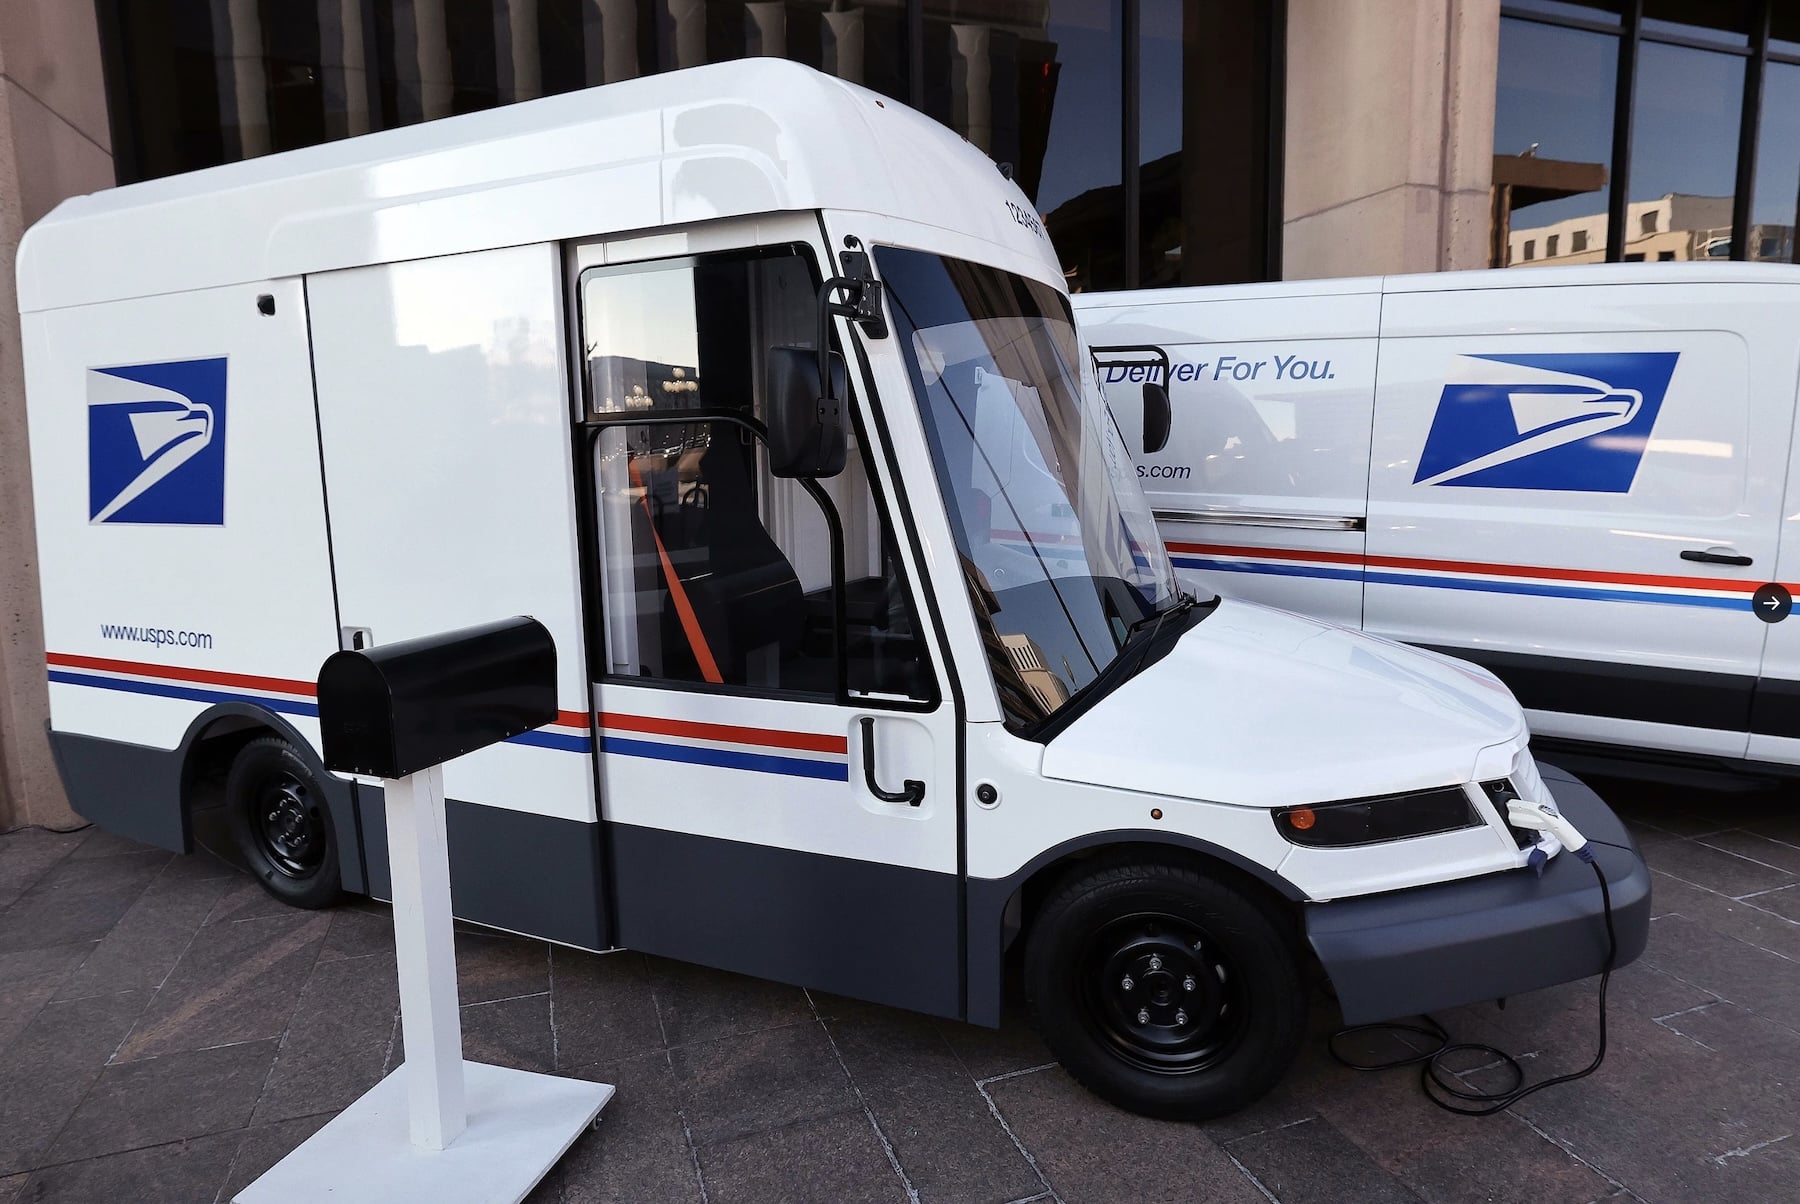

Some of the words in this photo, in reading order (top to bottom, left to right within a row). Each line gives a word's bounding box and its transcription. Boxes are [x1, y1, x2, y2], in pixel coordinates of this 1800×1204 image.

[1213, 356, 1266, 381] For
[1273, 355, 1335, 380] You.
[100, 623, 212, 649] www.usps.com
